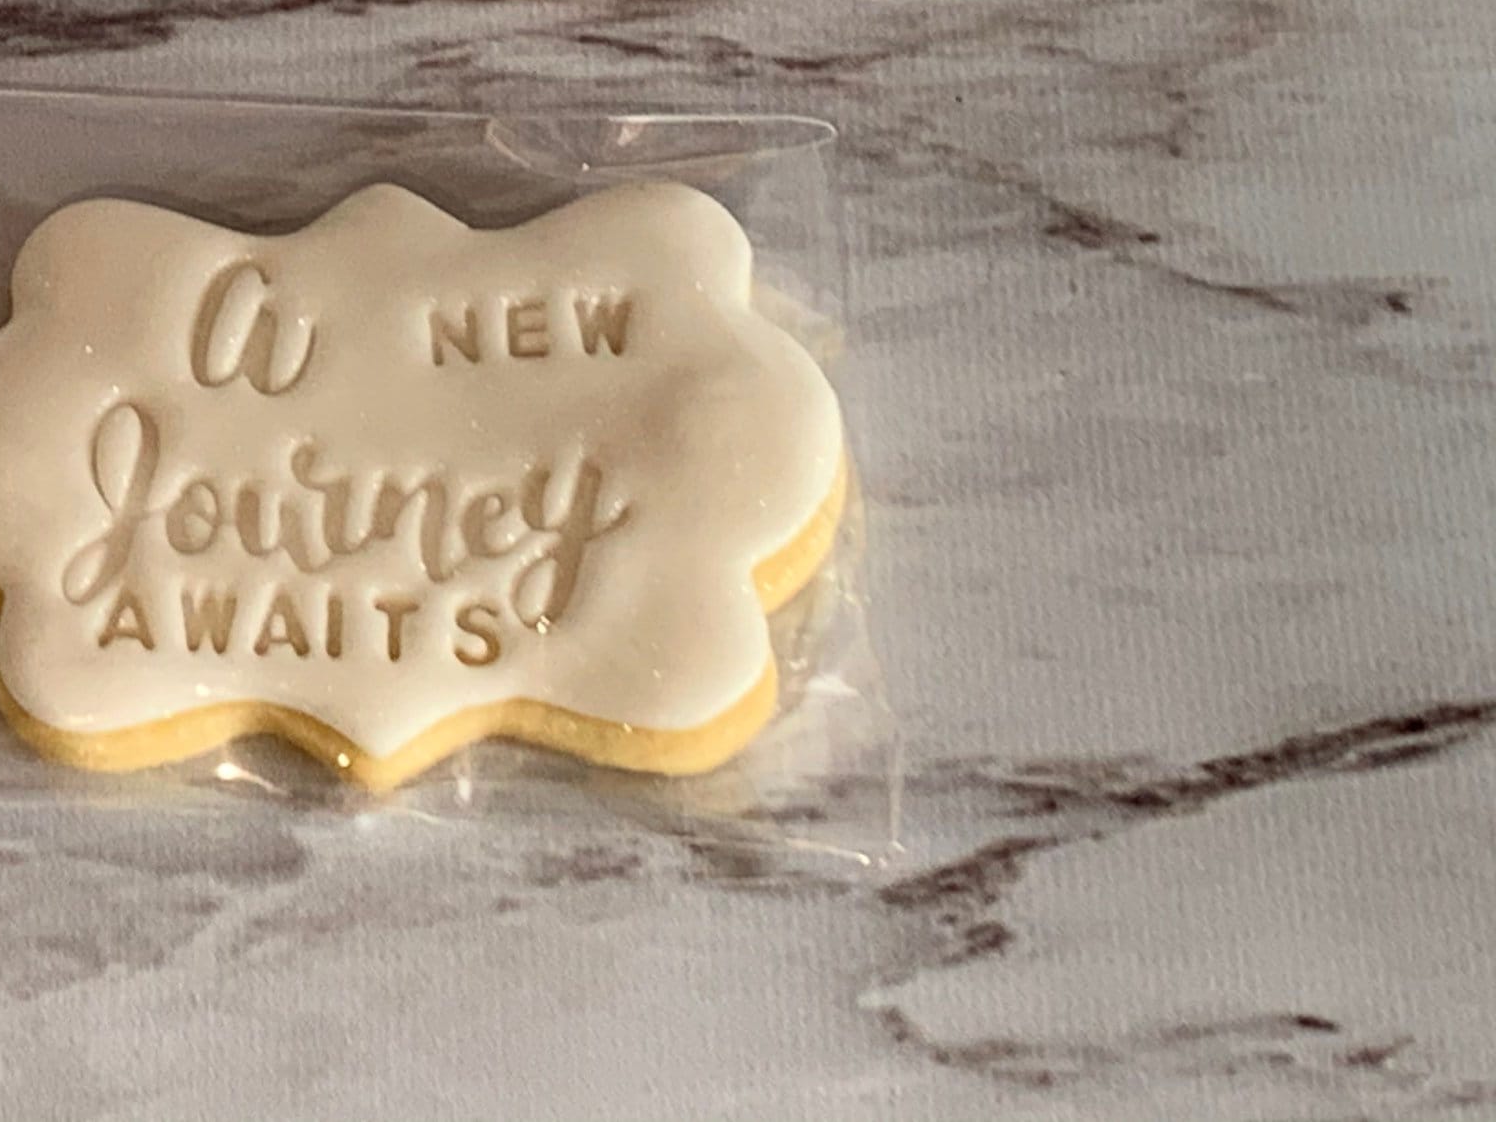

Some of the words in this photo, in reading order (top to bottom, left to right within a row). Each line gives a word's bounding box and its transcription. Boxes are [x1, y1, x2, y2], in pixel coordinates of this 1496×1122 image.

[428, 295, 632, 367] NEW
[61, 401, 632, 632] Journey
[97, 592, 504, 667] AWAITS
